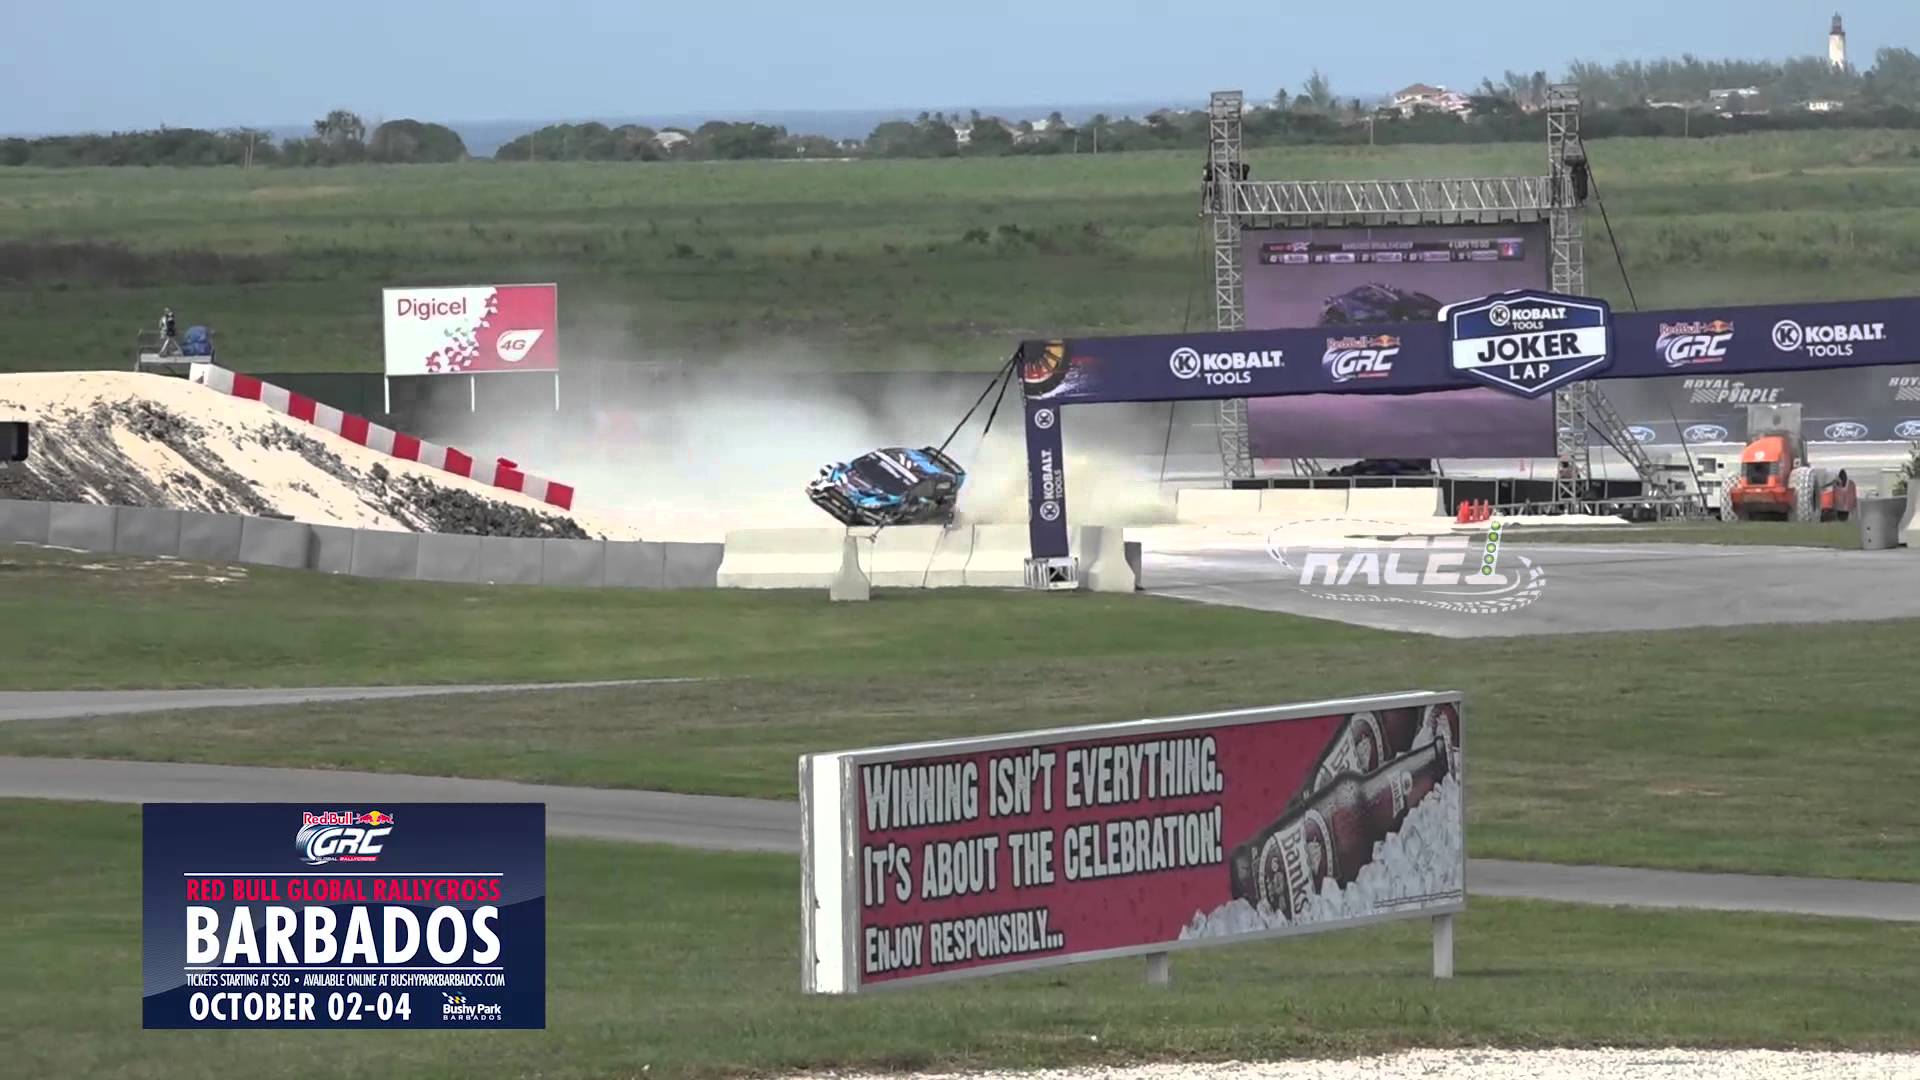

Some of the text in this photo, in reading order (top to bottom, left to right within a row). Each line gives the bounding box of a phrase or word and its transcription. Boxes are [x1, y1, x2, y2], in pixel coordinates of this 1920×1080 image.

[397, 298, 467, 320] Digicel
[1512, 308, 1566, 320] KOBALT
[1513, 321, 1544, 330] TOOLS
[1805, 323, 1885, 343] KOBALT
[500, 339, 526, 350] 4G
[1477, 332, 1582, 363] JOKER
[1671, 333, 1734, 360] GRC
[1806, 344, 1853, 357] TOOLS
[1202, 350, 1283, 370] KOBALT
[1337, 347, 1400, 375] GRC
[1204, 371, 1251, 385] TOOLS
[1509, 363, 1550, 380] LAP
[1683, 379, 1730, 389] ROYAL
[1716, 388, 1781, 403] PURPLE
[1692, 428, 1719, 440] Ford
[1833, 425, 1860, 438] Ford
[1041, 449, 1055, 500] KOBALT
[1054, 469, 1063, 499] TOOLS
[988, 748, 1056, 817] ISN'T
[1065, 735, 1224, 810] EVERYTHING.
[921, 836, 999, 899] ABOUT
[1008, 830, 1055, 887] THE
[1063, 805, 1224, 881] CELEBRATION!
